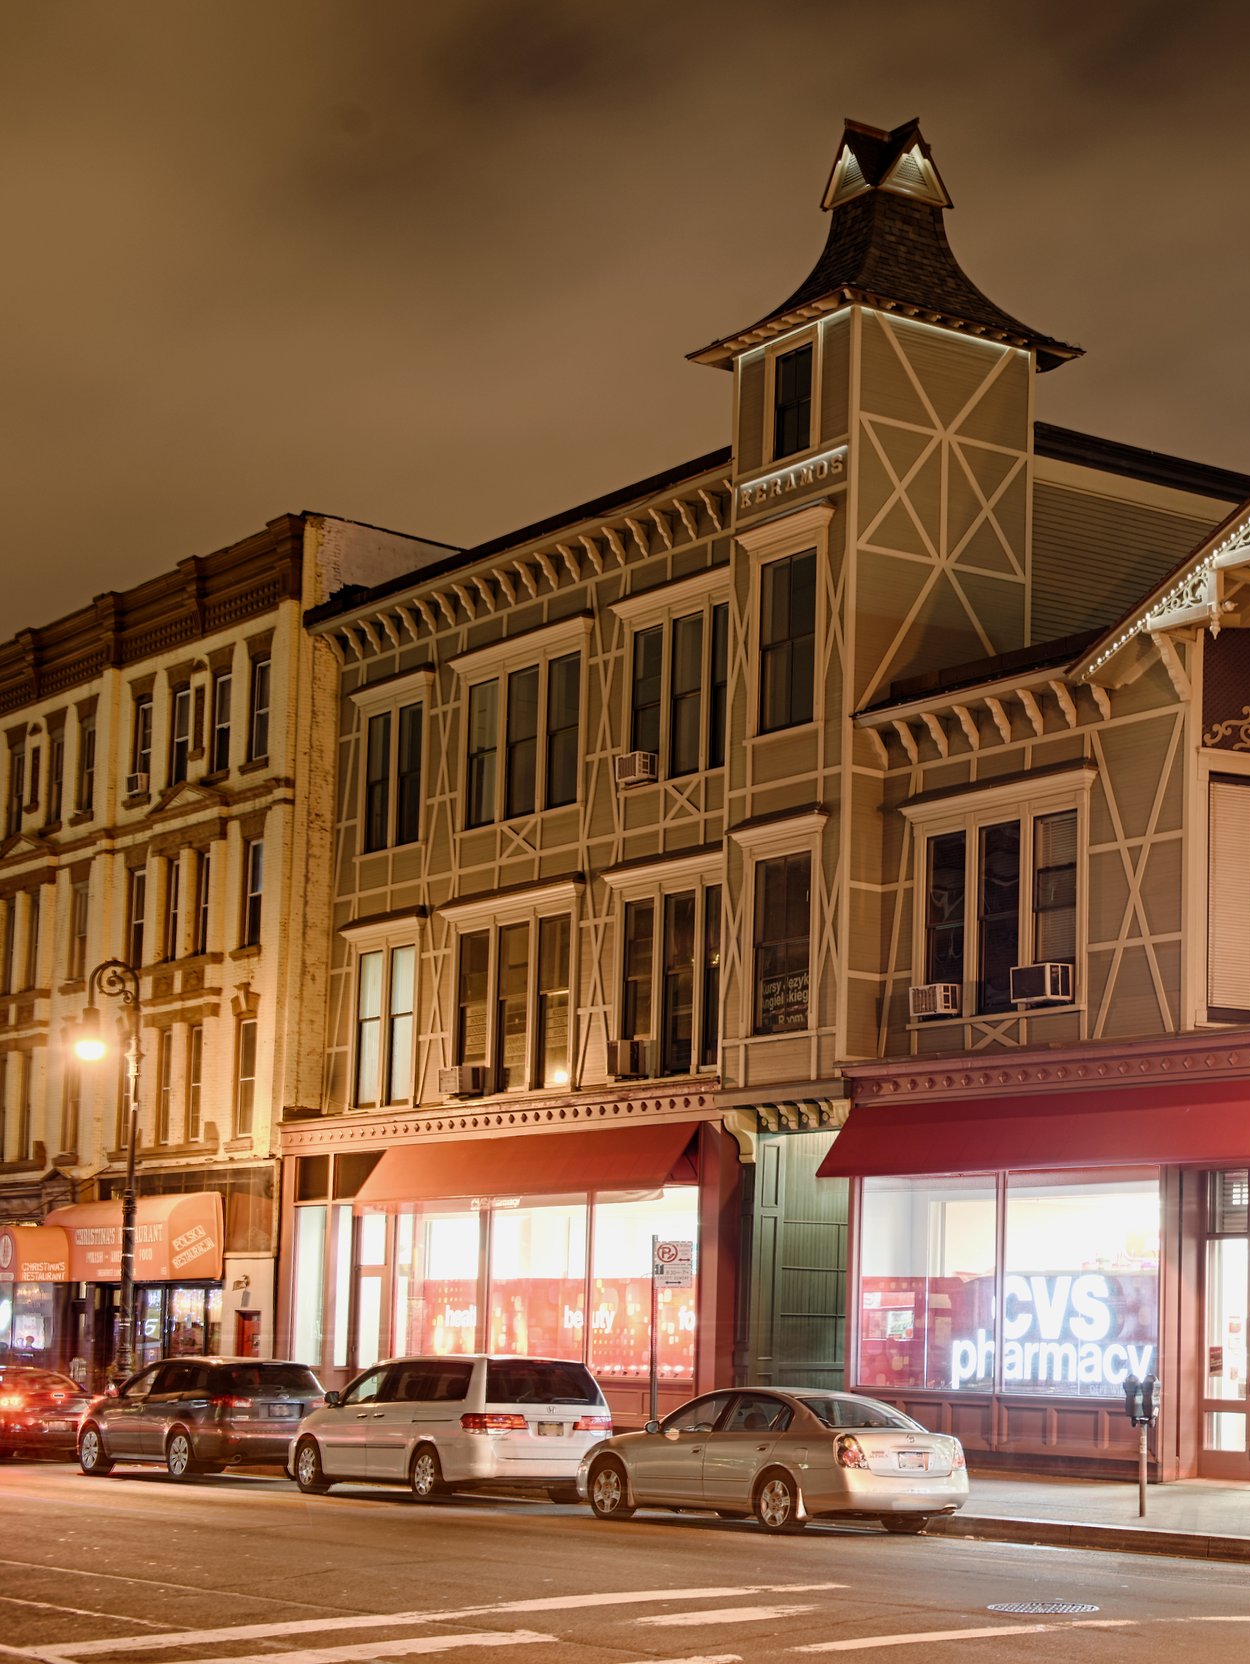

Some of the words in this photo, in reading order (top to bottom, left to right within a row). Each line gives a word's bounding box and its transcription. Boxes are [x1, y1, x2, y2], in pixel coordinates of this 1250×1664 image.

[741, 454, 843, 508] KERAMOS
[22, 1261, 66, 1272] CHRISTINA'S
[22, 1271, 66, 1281] RESTAURANT
[445, 1304, 477, 1328] heal
[563, 1304, 616, 1333] beuty
[991, 1274, 1111, 1341] CVS
